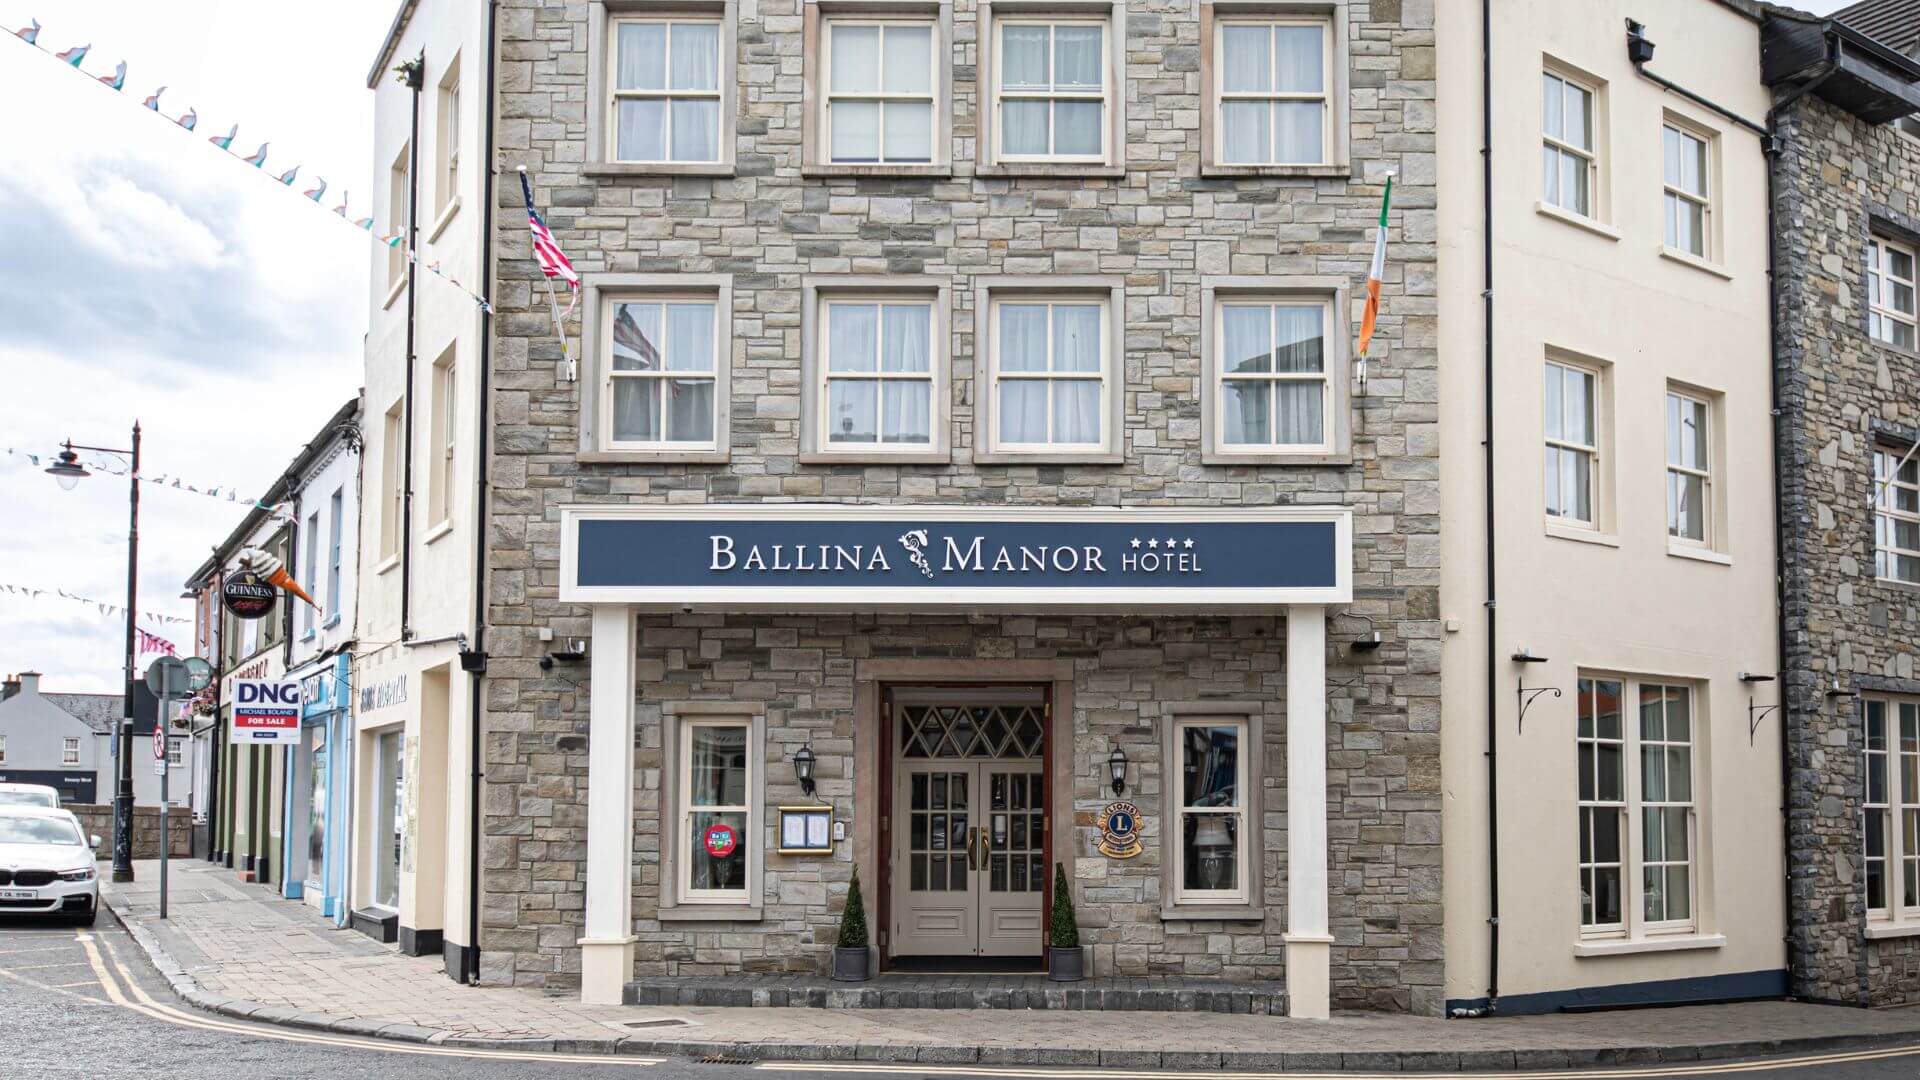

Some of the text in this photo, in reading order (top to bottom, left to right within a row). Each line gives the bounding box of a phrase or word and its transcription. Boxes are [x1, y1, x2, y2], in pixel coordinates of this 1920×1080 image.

[709, 535, 1107, 572] BALLINA MANOR
[1122, 552, 1202, 572] HOTEL
[225, 583, 272, 597] GUINNESS
[238, 682, 299, 704] DNG
[247, 717, 286, 725] FOR SALE
[1109, 803, 1134, 813] LIONS
[1116, 816, 1127, 831] L
